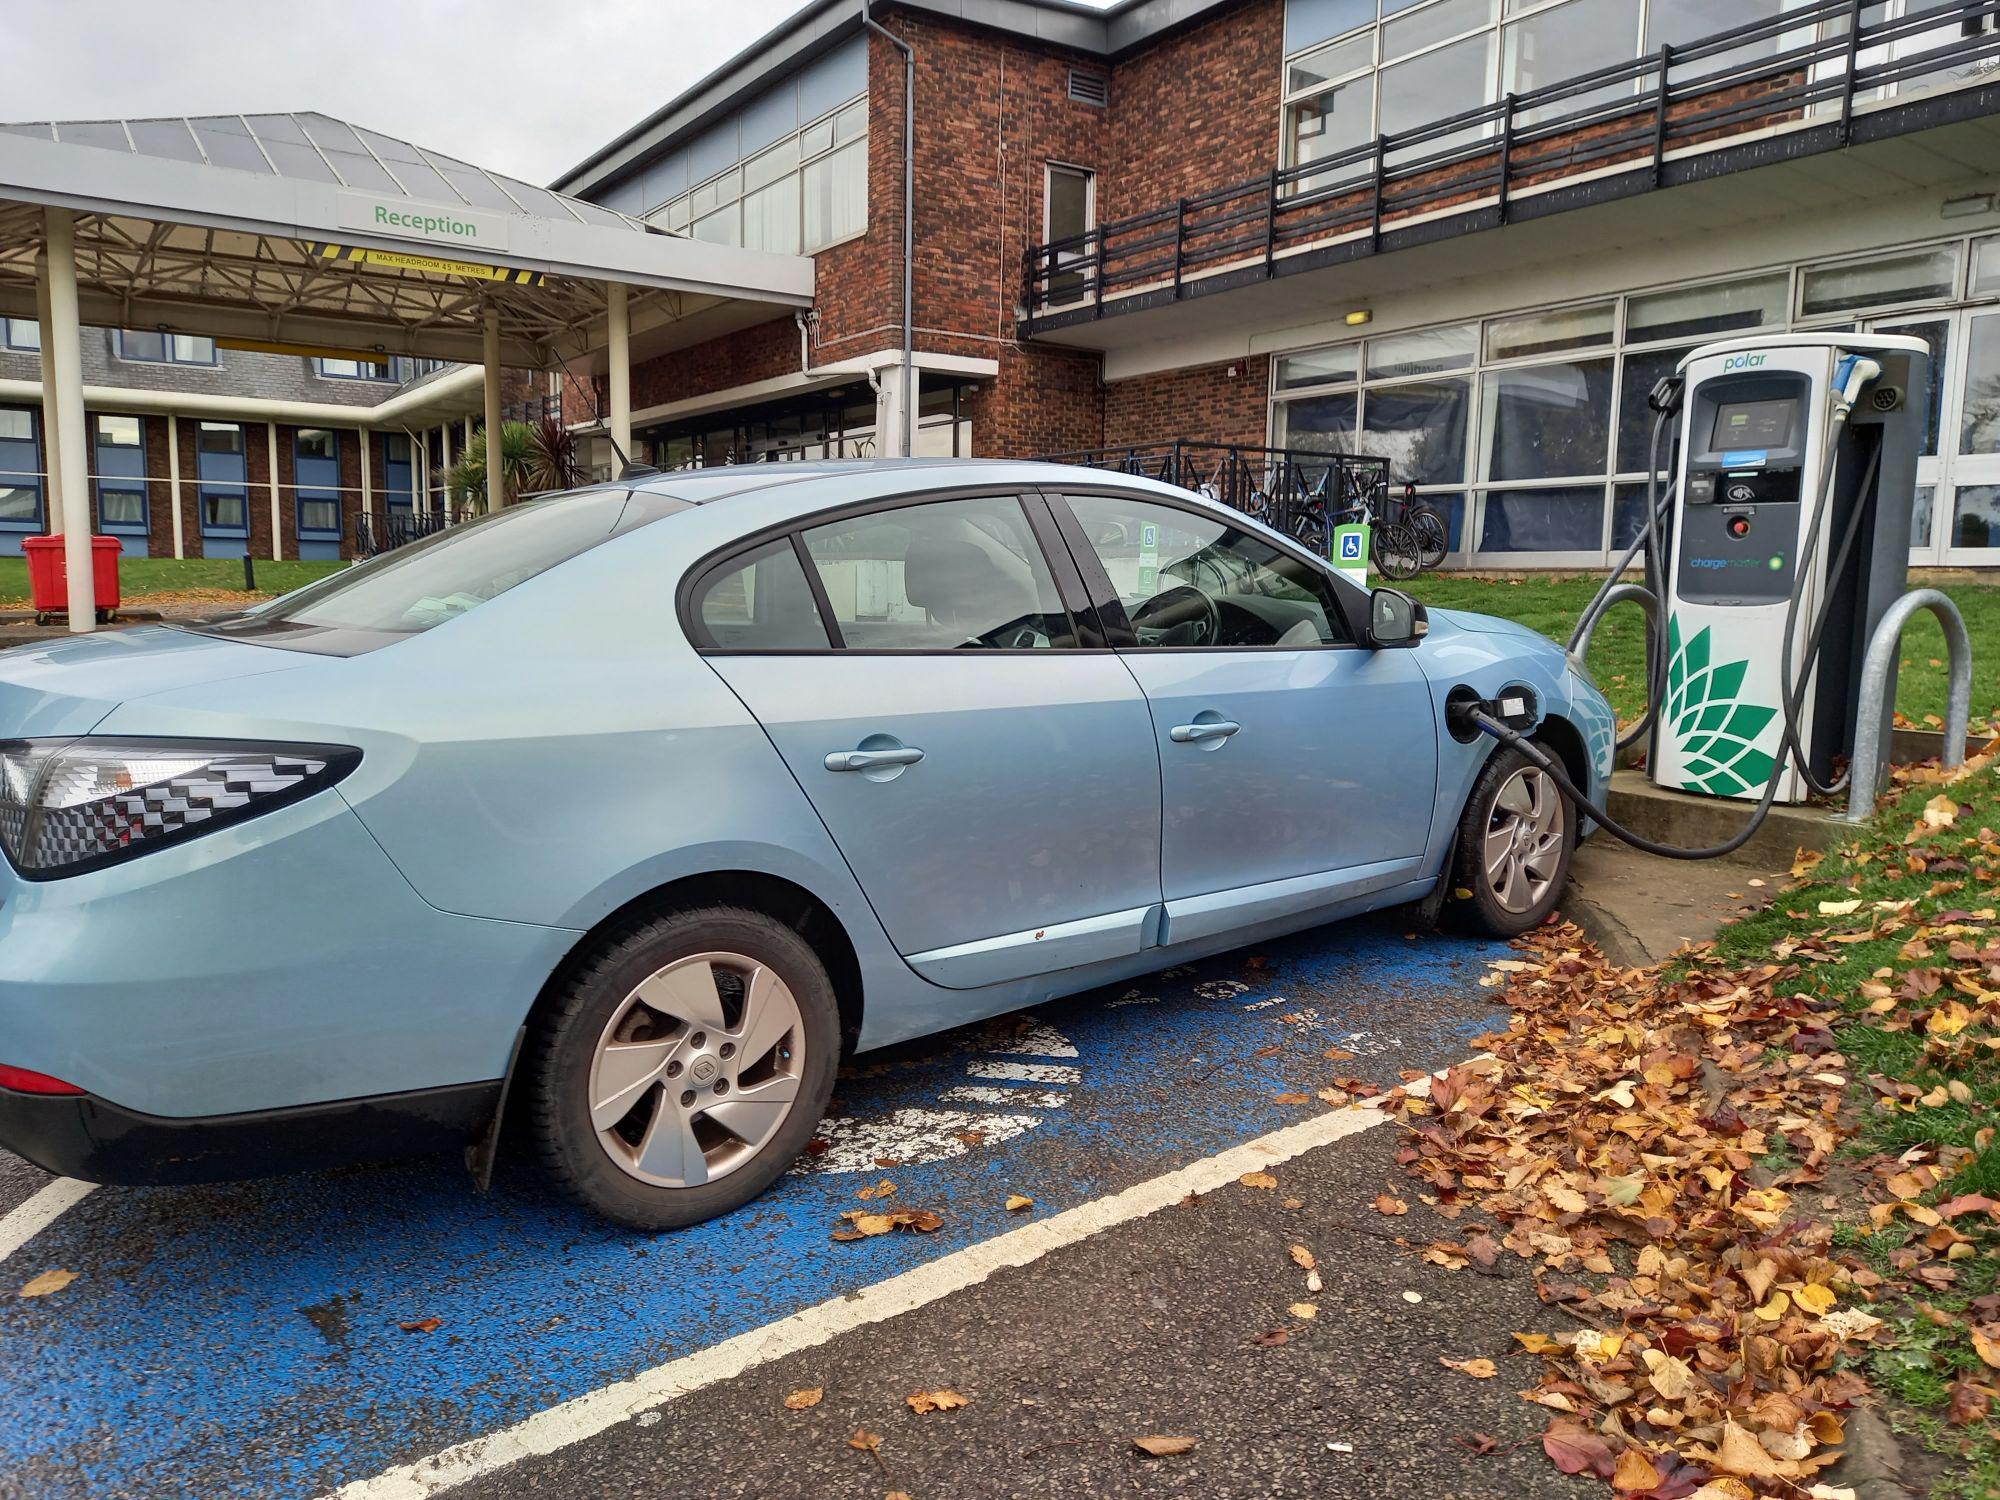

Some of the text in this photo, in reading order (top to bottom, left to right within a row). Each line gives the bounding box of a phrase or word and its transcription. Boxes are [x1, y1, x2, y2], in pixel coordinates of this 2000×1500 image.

[375, 206, 476, 237] Reception
[377, 254, 393, 262] MAX
[396, 256, 440, 268] HEADROOM
[456, 265, 485, 275] METRES
[1724, 353, 1767, 373] polar
